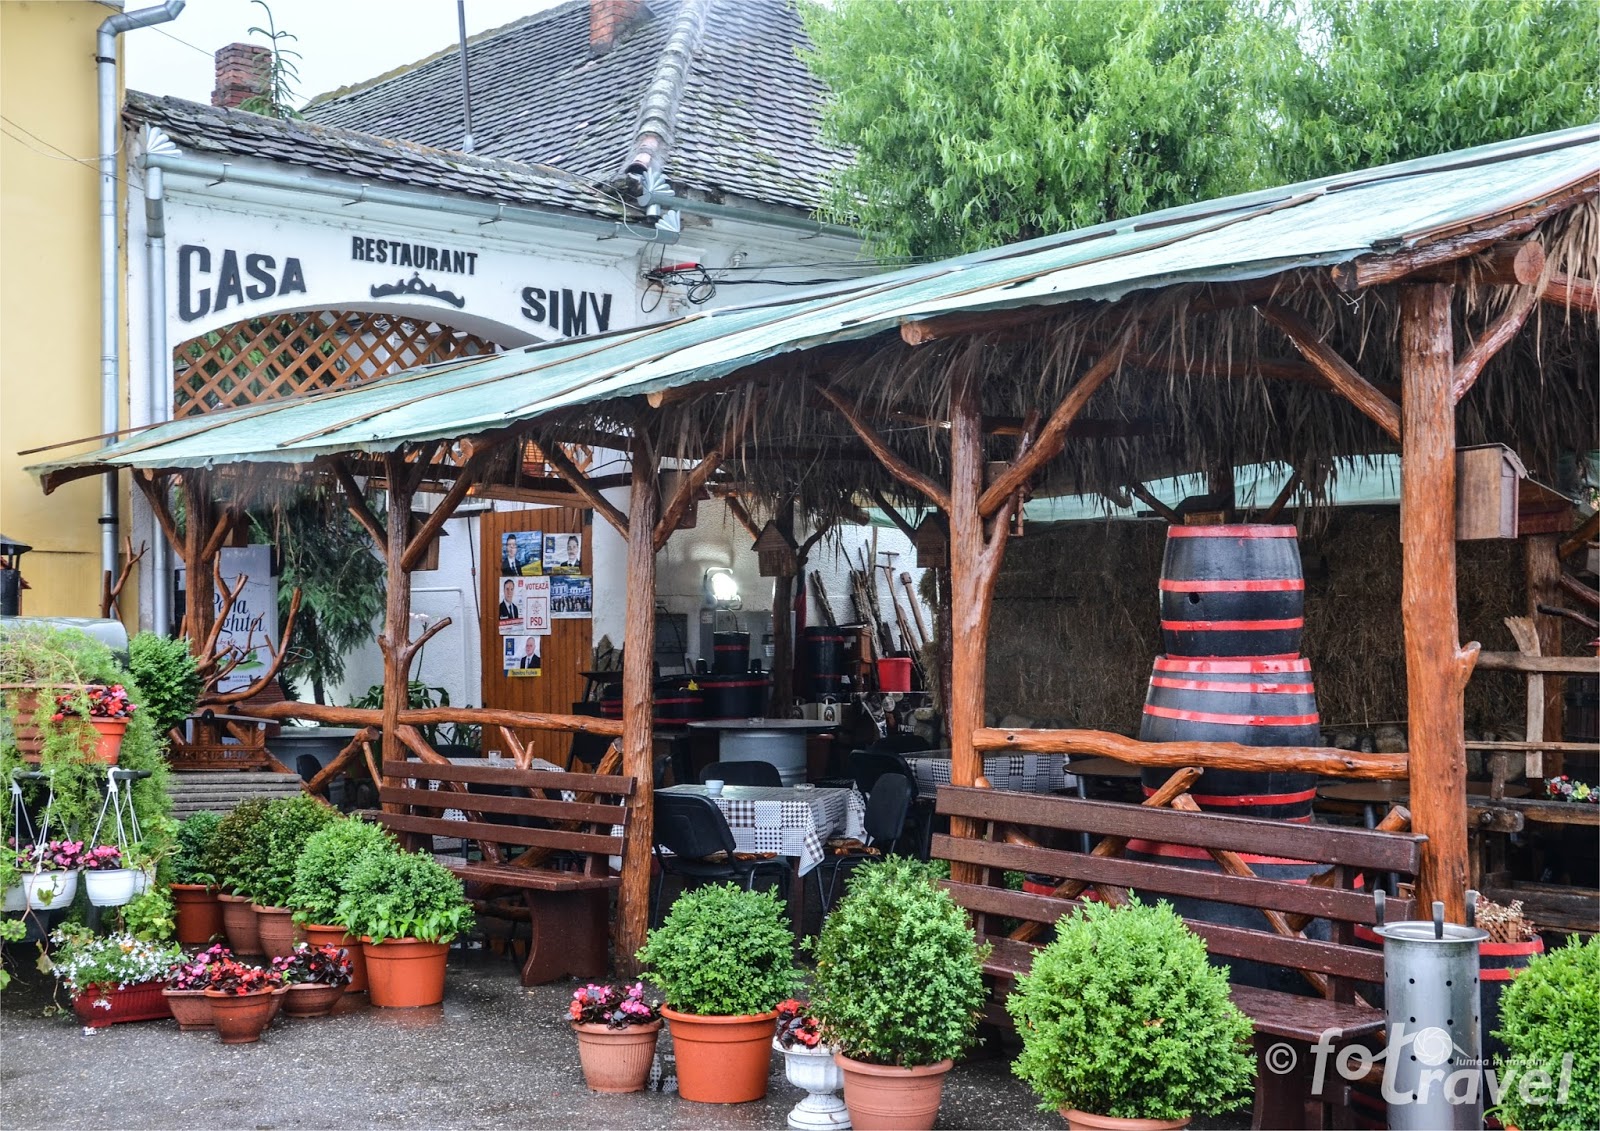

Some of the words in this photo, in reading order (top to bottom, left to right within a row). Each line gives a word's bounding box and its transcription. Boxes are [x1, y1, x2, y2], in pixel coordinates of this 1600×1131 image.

[352, 236, 478, 275] RESTAURANT
[179, 244, 307, 322] CASA
[530, 616, 543, 626] PSD
